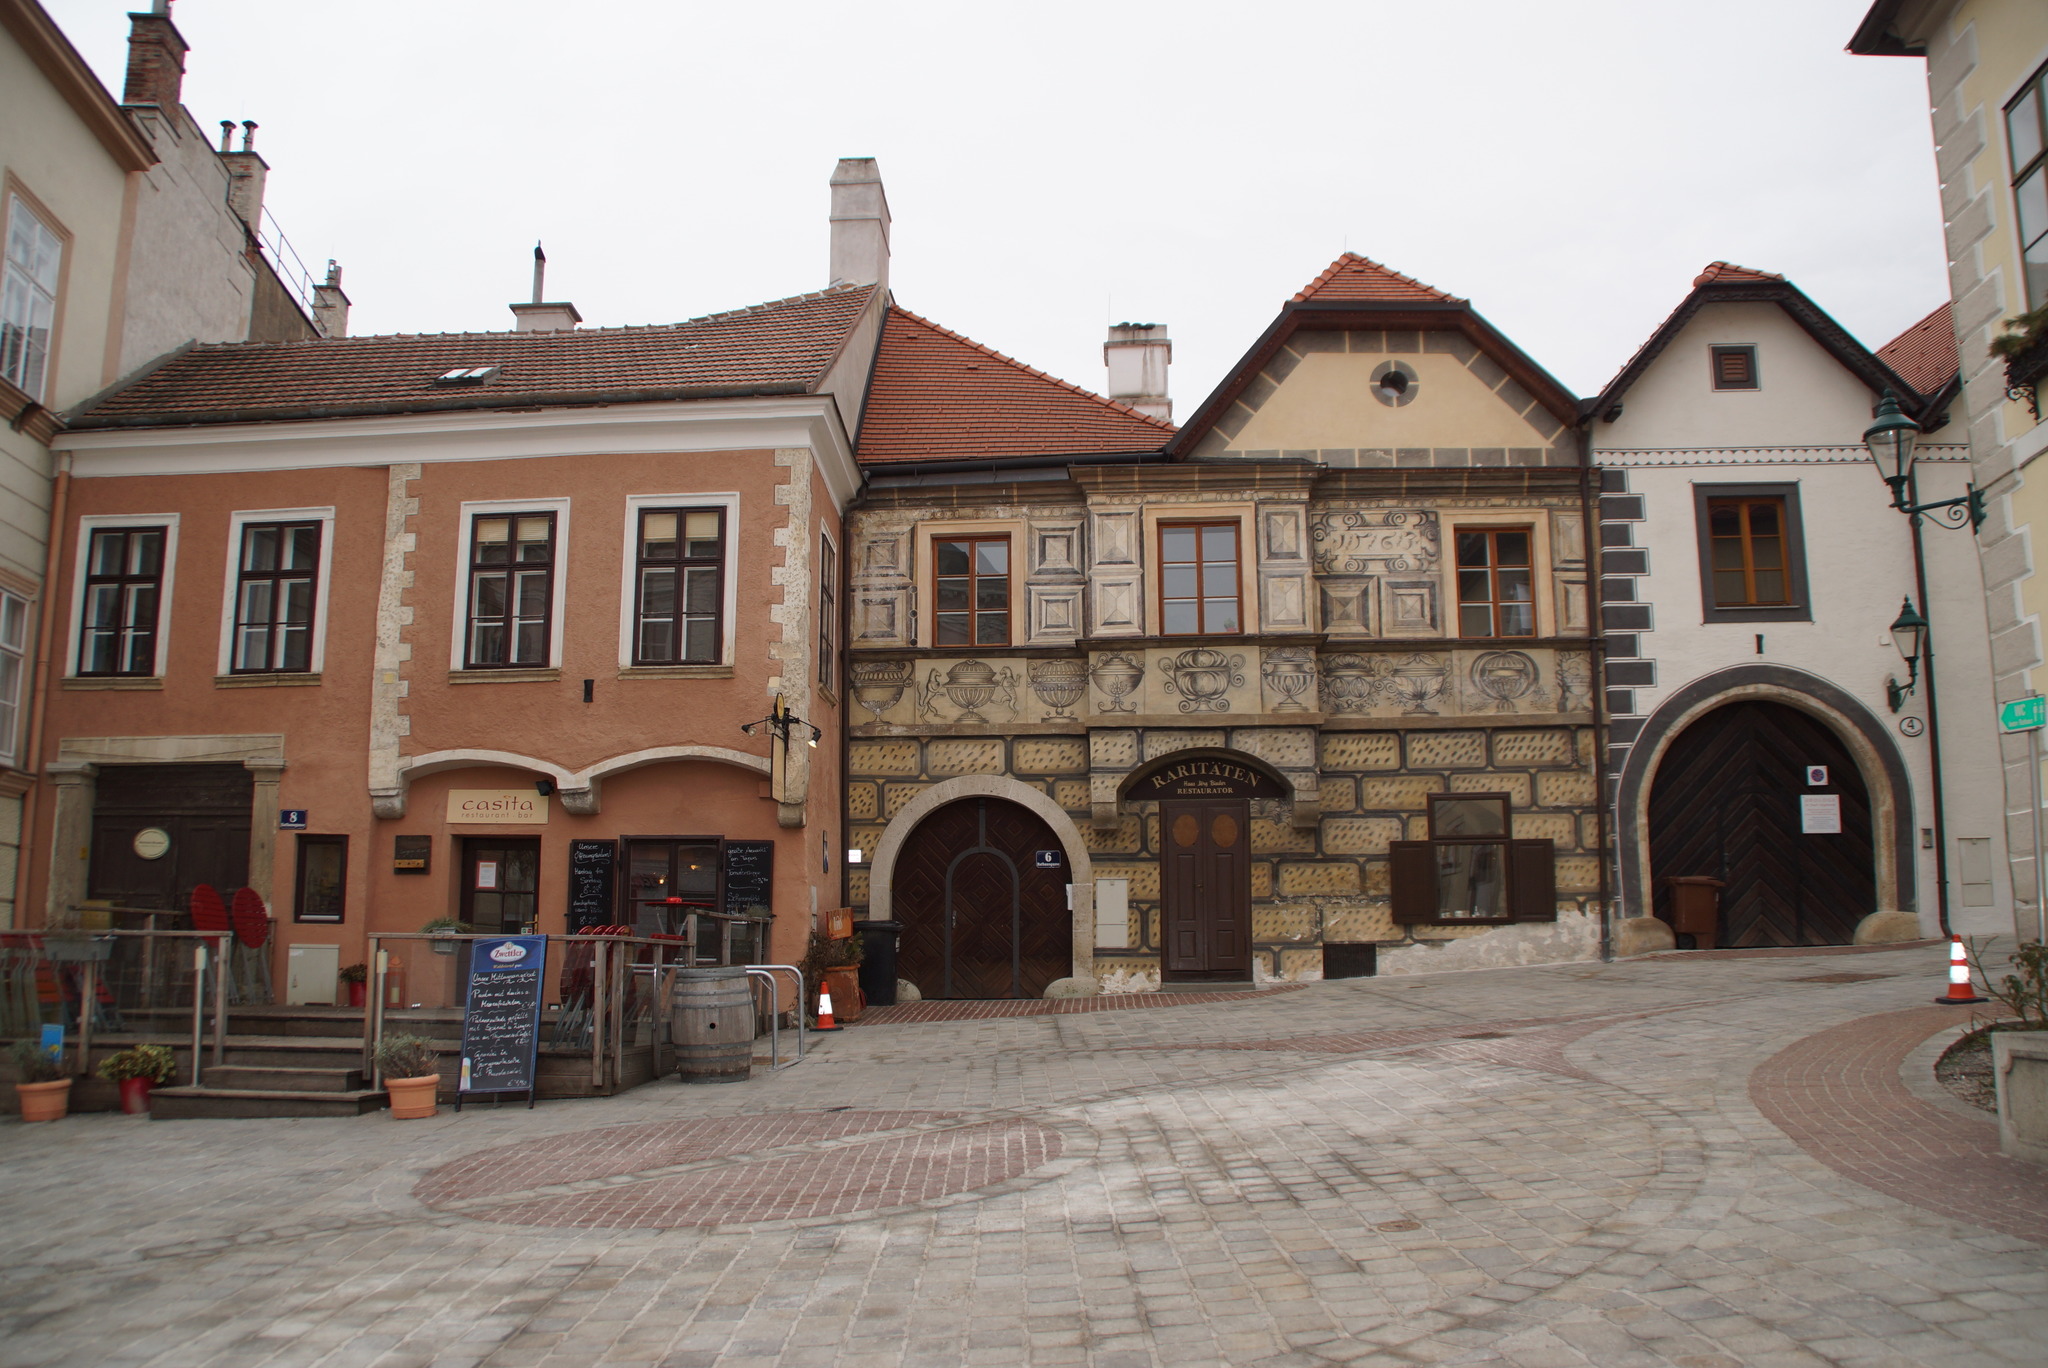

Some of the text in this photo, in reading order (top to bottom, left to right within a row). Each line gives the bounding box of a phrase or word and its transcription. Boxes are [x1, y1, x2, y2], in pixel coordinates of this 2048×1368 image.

[1907, 718, 1915, 730] 4
[1151, 761, 1262, 789] RARITÄTEN
[1177, 787, 1234, 795] RESTAURATOR
[462, 795, 534, 811] casita
[289, 811, 298, 823] 8
[517, 811, 534, 819] bar
[1044, 852, 1053, 863] 6
[494, 949, 524, 958] Zwettler
